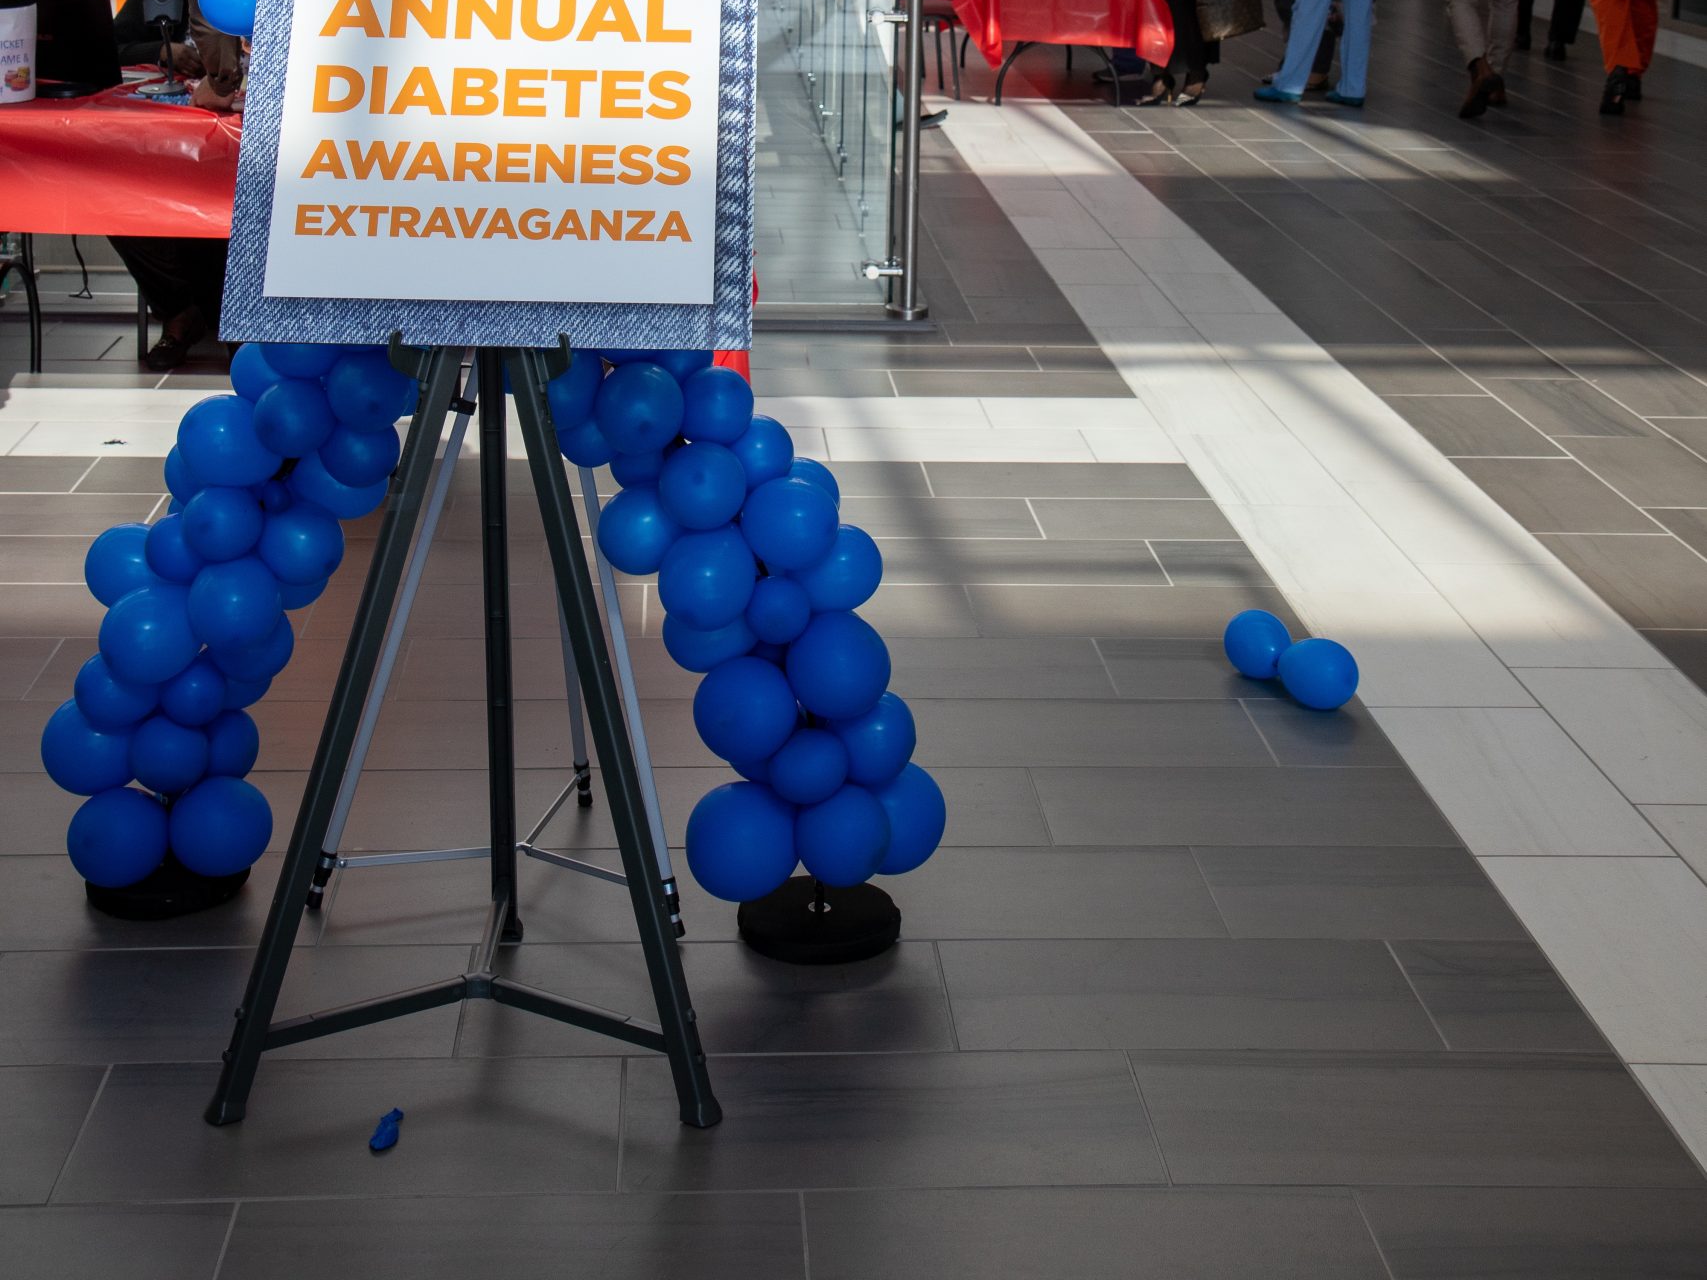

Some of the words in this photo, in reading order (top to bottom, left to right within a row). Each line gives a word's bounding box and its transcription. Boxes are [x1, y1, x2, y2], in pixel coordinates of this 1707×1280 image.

[0, 38, 24, 49] ICKET
[0, 54, 21, 65] AME
[312, 64, 692, 120] DIABETES
[301, 139, 692, 186] AWARENESS
[295, 204, 692, 243] EXTRAVAGANZA
